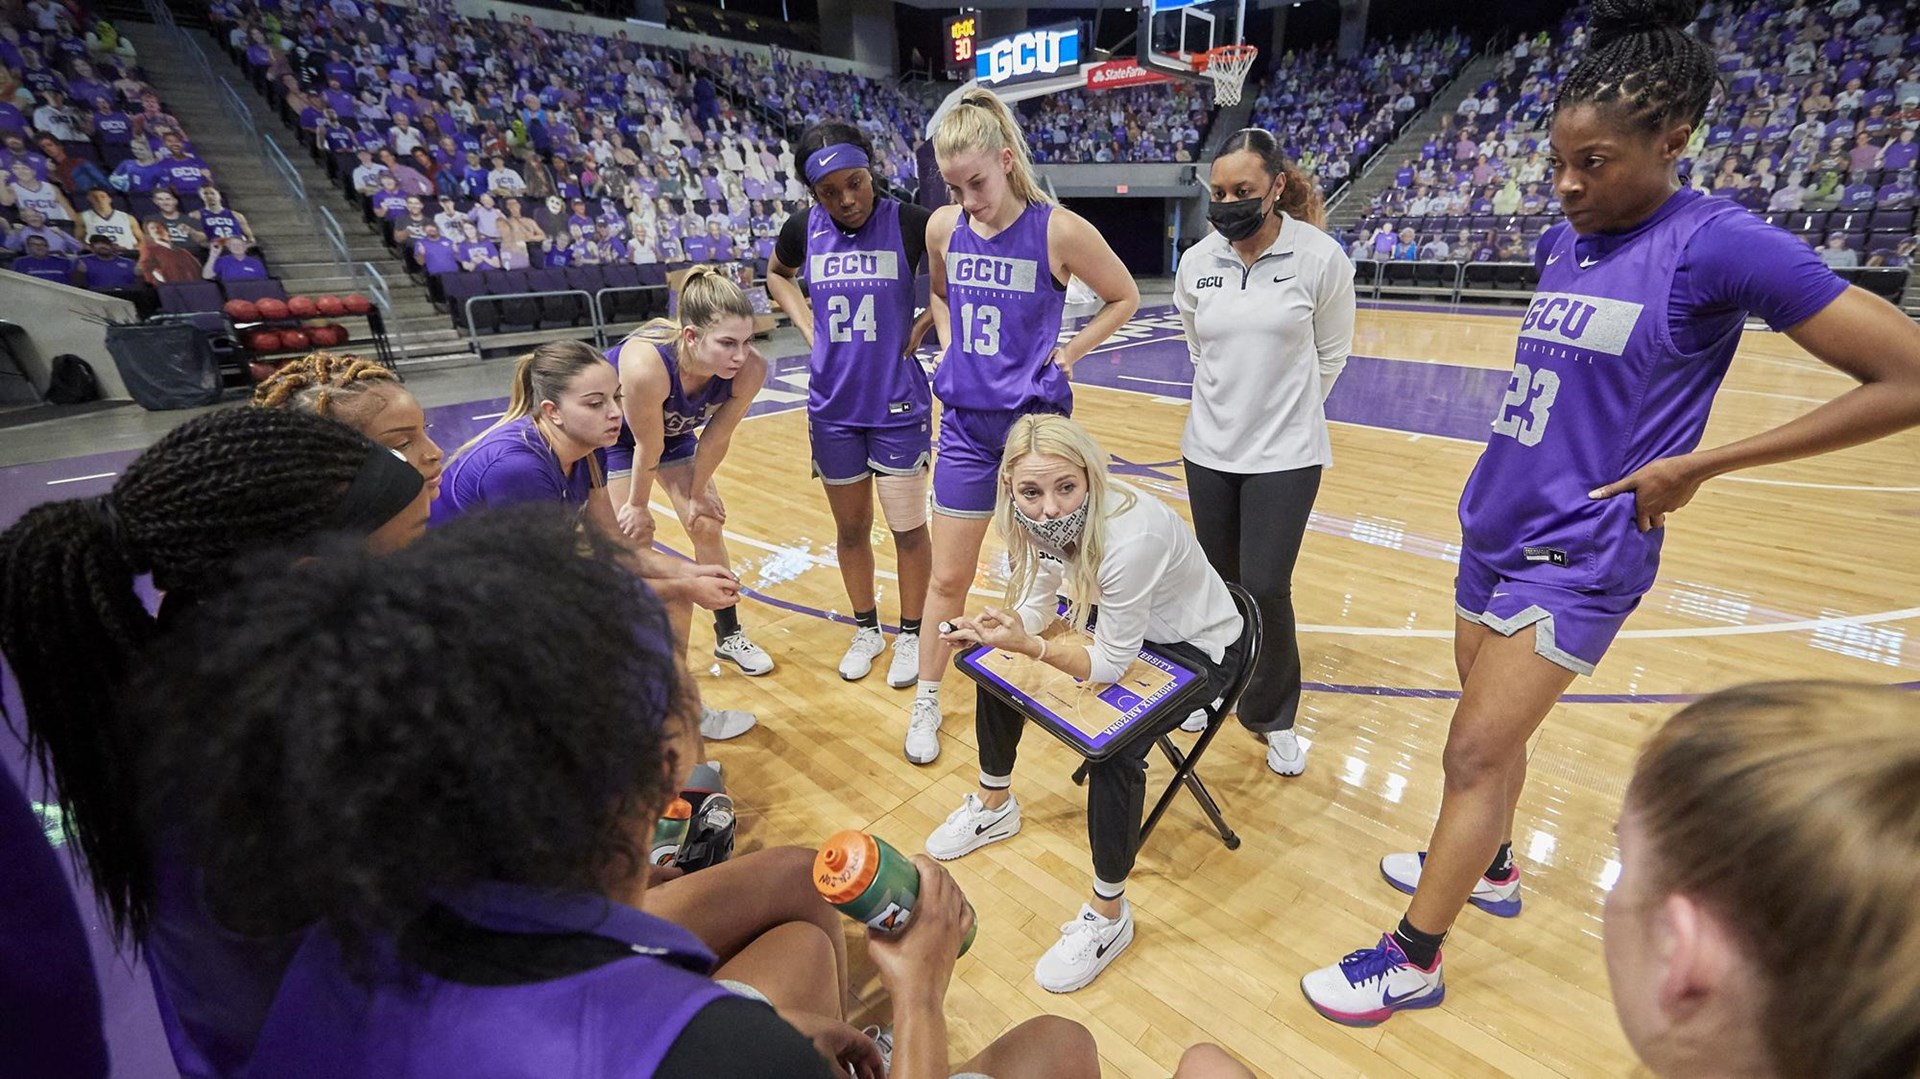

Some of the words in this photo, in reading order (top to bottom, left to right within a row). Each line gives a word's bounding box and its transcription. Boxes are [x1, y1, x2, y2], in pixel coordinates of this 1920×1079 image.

[955, 37, 971, 61] 30
[989, 31, 1061, 84] GCU
[100, 120, 127, 130] GCU
[171, 166, 201, 178] GCU
[23, 199, 57, 209] GCU
[95, 225, 124, 236] GCU
[205, 216, 234, 227] GCU
[213, 227, 235, 238] 42
[823, 254, 878, 278] GCU
[955, 258, 1014, 286] GCU
[1196, 276, 1224, 290] GCU
[827, 294, 877, 343] 24
[960, 302, 1001, 356] 13
[1520, 297, 1598, 341] GCU
[1492, 363, 1561, 447] 23
[1062, 513, 1078, 533] GCU
[1553, 553, 1562, 562] M
[1141, 681, 1178, 709] PHOENIX
[1103, 705, 1143, 736] ARIZONA
